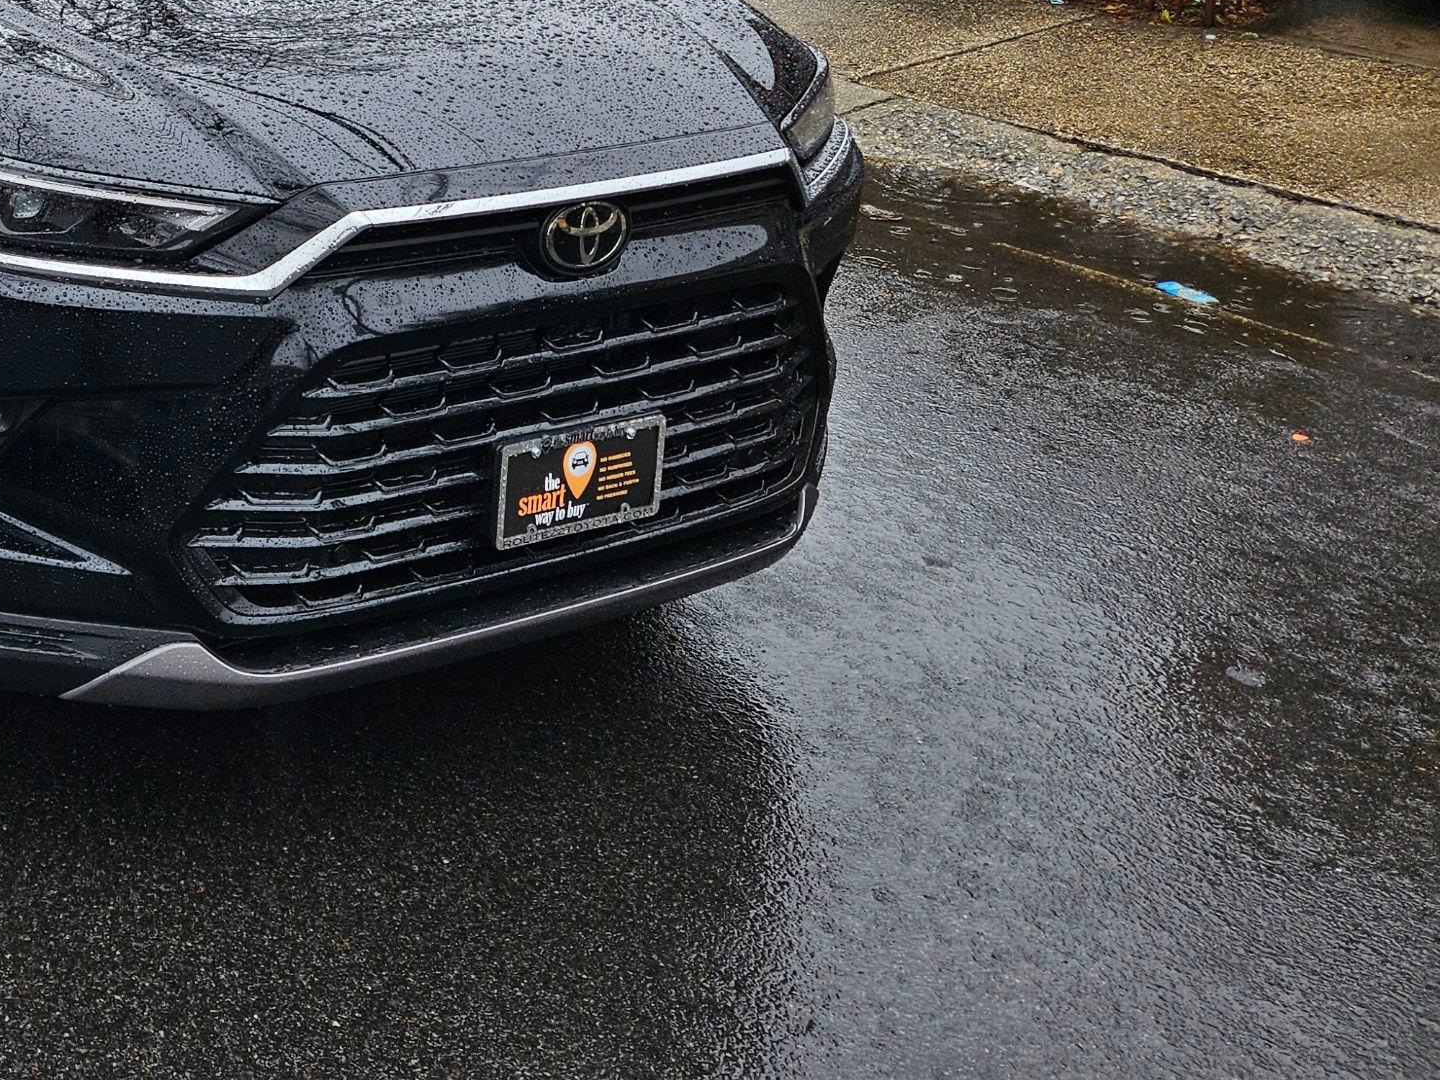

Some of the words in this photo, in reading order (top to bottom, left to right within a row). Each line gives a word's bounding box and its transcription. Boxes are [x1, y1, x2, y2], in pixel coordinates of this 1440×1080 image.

[545, 473, 561, 492] the
[518, 484, 567, 517] smart
[535, 508, 554, 526] way
[555, 507, 566, 520] to
[567, 501, 586, 519] buy
